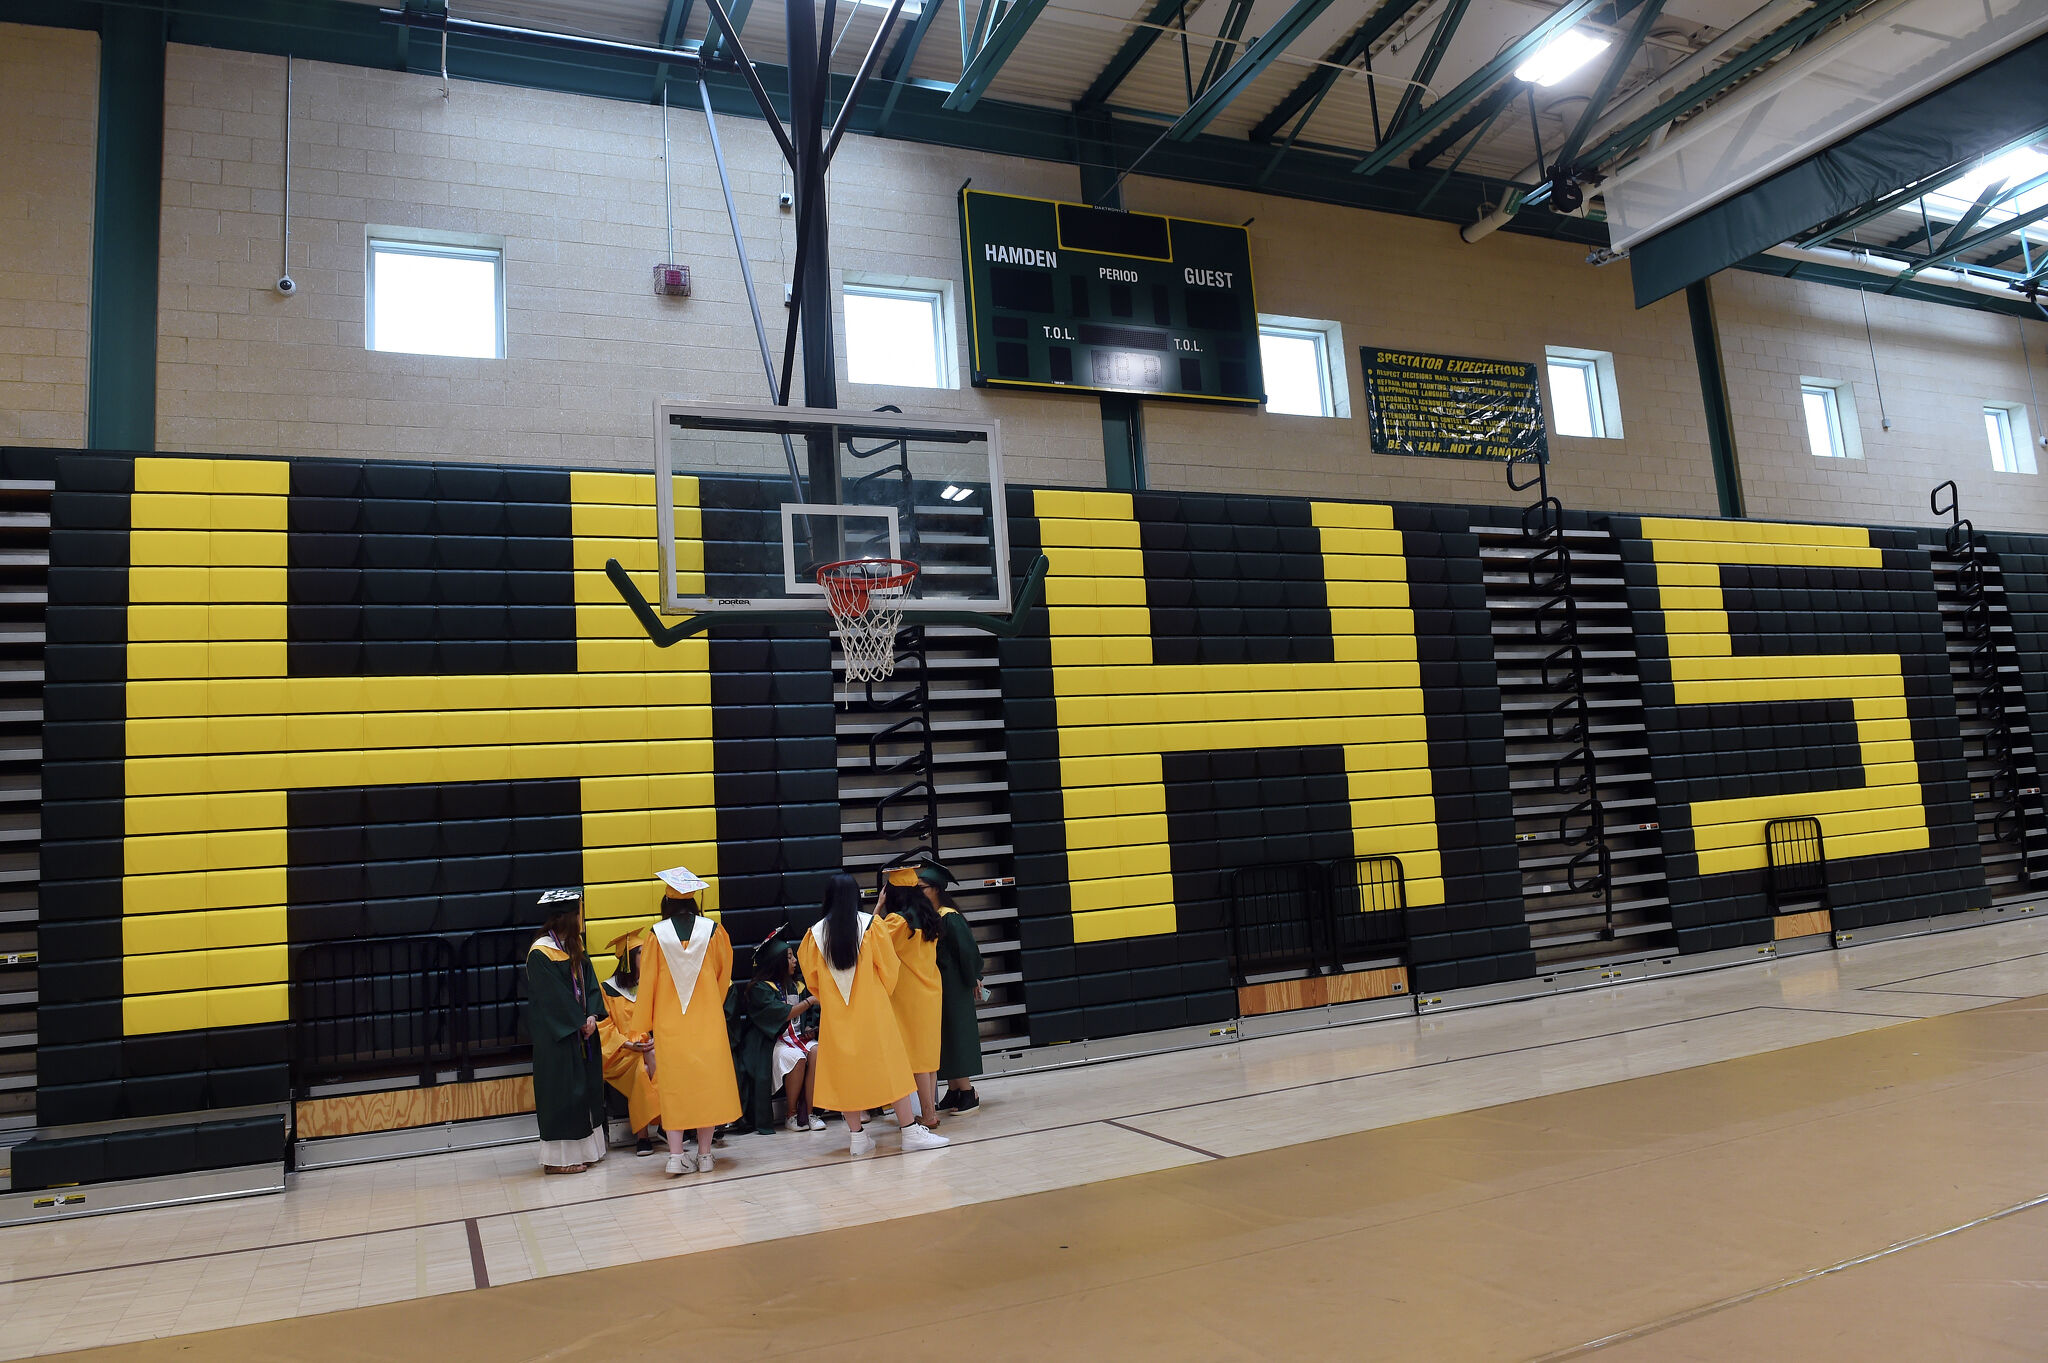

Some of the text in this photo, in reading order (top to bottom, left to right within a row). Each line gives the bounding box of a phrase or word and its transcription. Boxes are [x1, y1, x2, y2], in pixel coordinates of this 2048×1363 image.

[984, 243, 1058, 269] HAMDEN
[1099, 267, 1139, 283] PERIOD
[1184, 267, 1233, 289] GUEST
[1043, 325, 1075, 341] T.O.L.
[1173, 338, 1203, 352] T.O.L.
[1376, 352, 1526, 377] SPECTATOR EXPECTATIONS
[1402, 371, 1433, 380] DECISIONS
[1378, 386, 1419, 396] INAPPROPRIATE
[1401, 381, 1418, 389] FROM
[1387, 439, 1402, 450] BE
[1474, 445, 1483, 456] A
